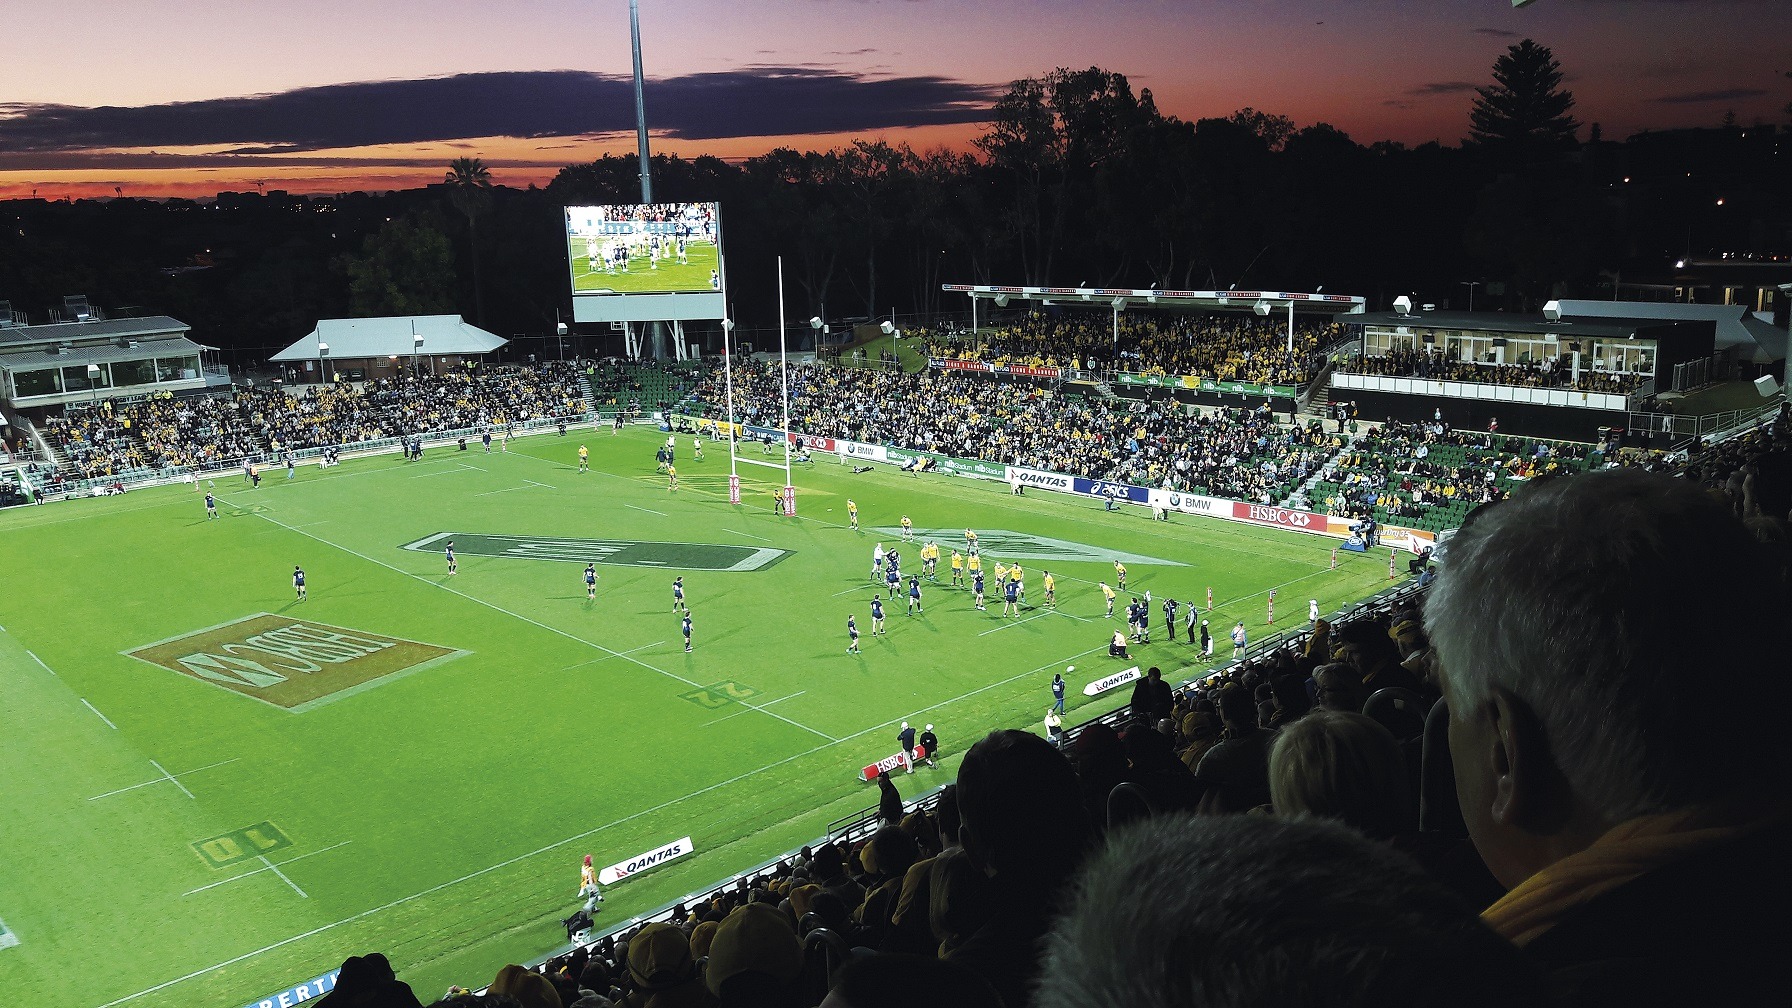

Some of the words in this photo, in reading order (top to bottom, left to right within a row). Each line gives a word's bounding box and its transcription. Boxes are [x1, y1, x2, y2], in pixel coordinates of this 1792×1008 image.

[857, 446, 875, 456] BMW
[1019, 472, 1068, 488] QANTAS
[1185, 497, 1211, 510] BMW
[1249, 505, 1289, 524] HSBC
[1102, 670, 1134, 689] QANTAS
[876, 752, 905, 773] HSBC
[626, 844, 681, 873] QANTAS
